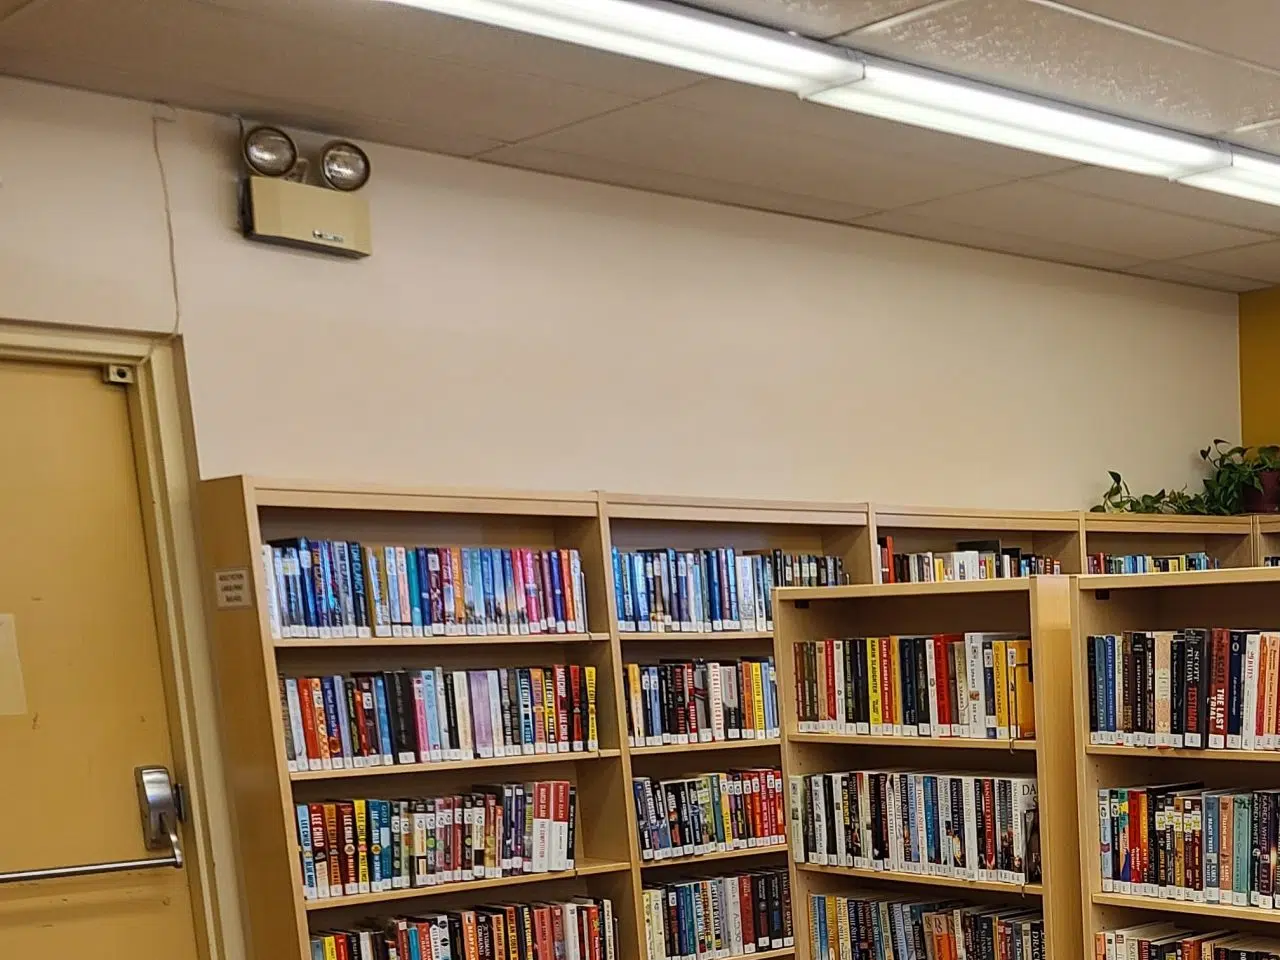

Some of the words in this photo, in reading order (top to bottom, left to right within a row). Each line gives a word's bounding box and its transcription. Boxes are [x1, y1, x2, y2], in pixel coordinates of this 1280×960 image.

[1186, 647, 1194, 683] TUROW
[557, 669, 566, 698] MATCHUP
[871, 660, 879, 693] SLAUGHTER
[1217, 688, 1225, 707] THE
[1187, 687, 1198, 732] TESTIMONY
[1209, 696, 1217, 720] TRIAL
[1216, 708, 1225, 730] LAST
[644, 780, 653, 799] CLIVE
[311, 813, 322, 825] LEE
[344, 815, 352, 826] LEE
[371, 811, 379, 820] LEE
[647, 798, 656, 824] CUSSLER
[300, 819, 308, 829] LEE
[302, 831, 311, 847] CHILD
[313, 827, 324, 847] CHILD
[345, 827, 354, 843] CHILD
[372, 829, 380, 843] CHILD
[305, 861, 313, 873] BLUE
[711, 884, 719, 910] JEFFERY
[508, 910, 516, 933] HARLAN
[713, 911, 721, 935] DEAVER
[467, 926, 475, 945] READY
[510, 934, 518, 954] COBEN
